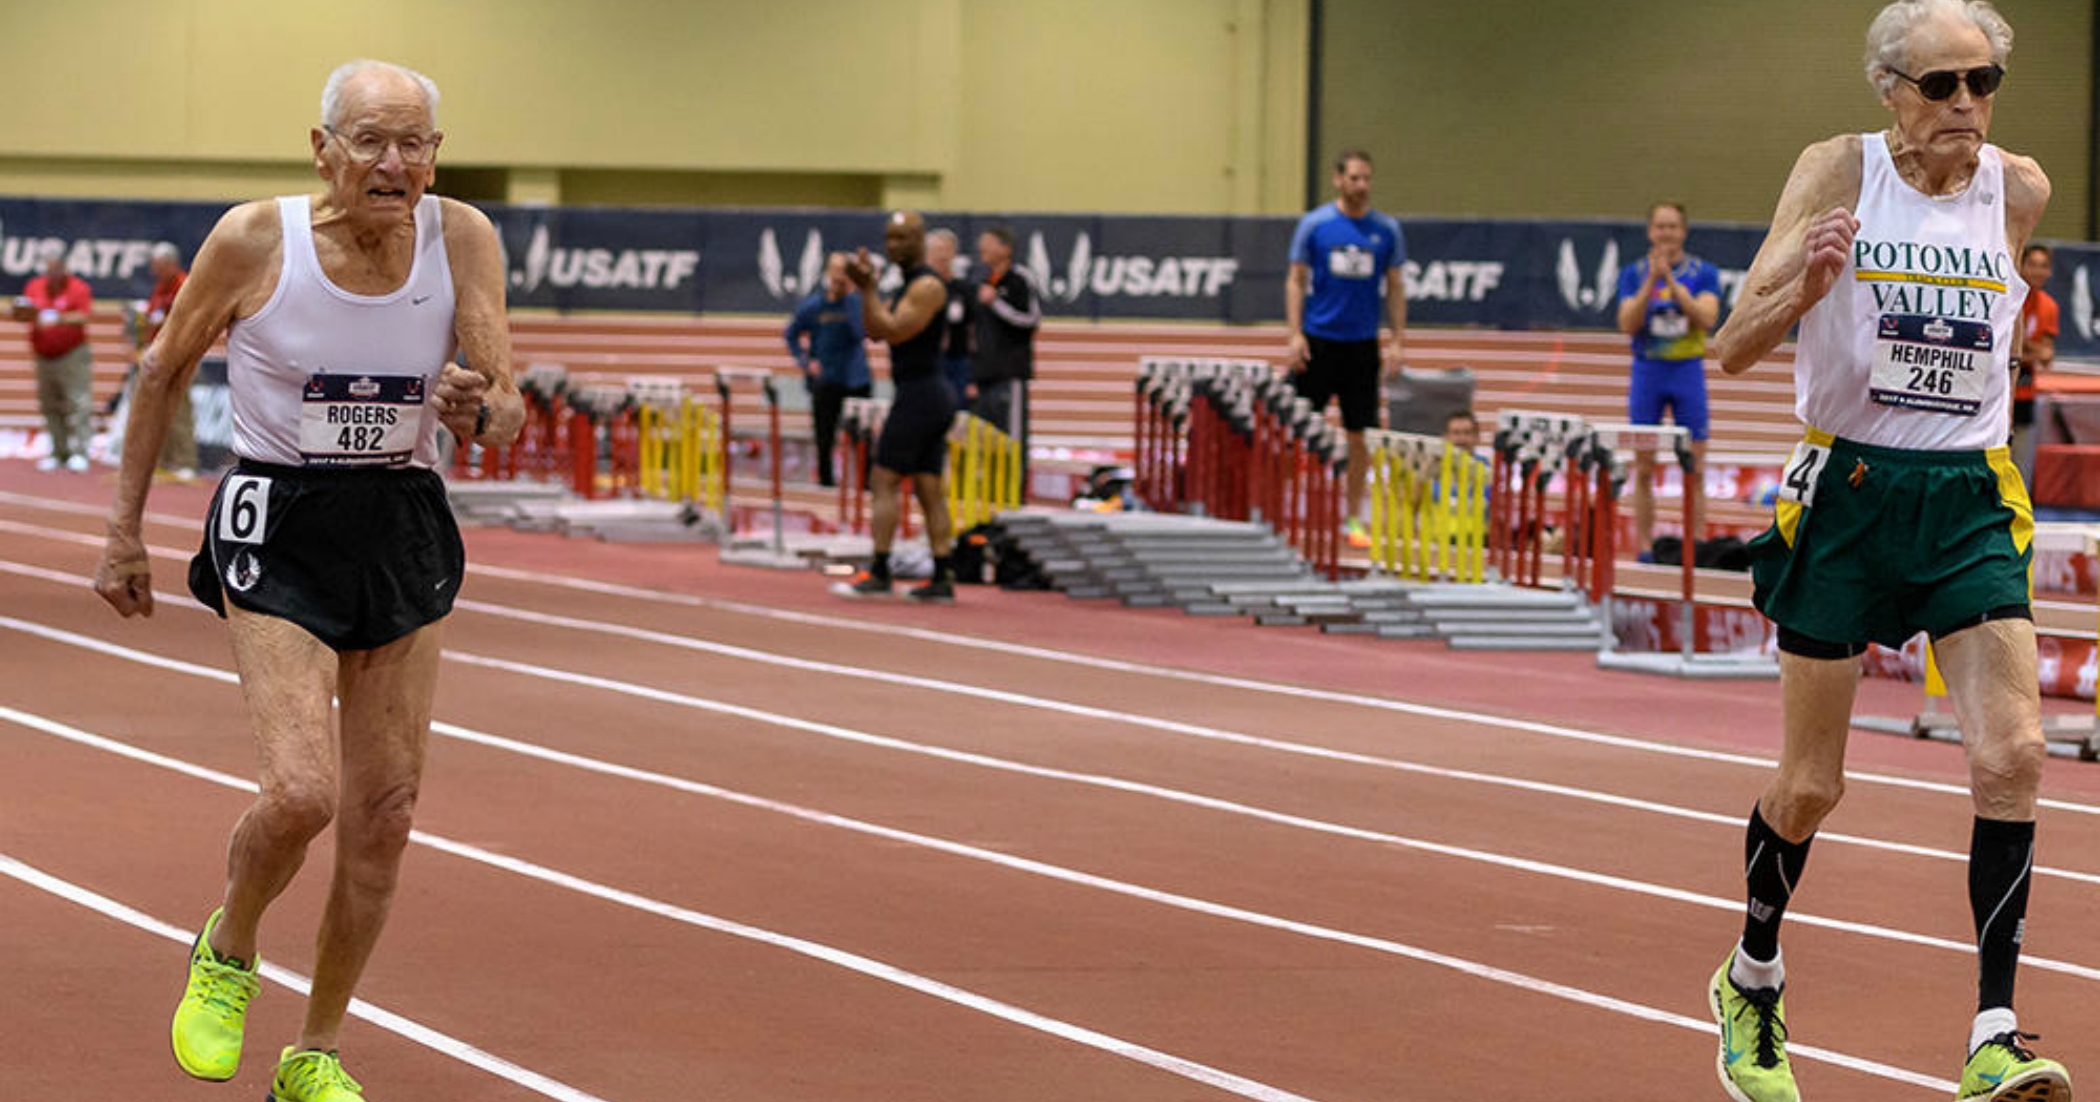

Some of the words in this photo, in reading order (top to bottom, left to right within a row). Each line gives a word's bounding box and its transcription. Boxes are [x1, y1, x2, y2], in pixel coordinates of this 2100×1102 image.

[550, 247, 700, 289] USATF
[1092, 255, 1240, 296] USATF
[1380, 259, 1503, 301] SATF
[1855, 240, 2008, 280] POTOMAC
[1871, 284, 1997, 320] VALLEY
[1891, 344, 1975, 371] HEMPHILL
[1907, 367, 1953, 394] 246
[327, 405, 398, 425] ROGERS
[338, 426, 384, 450] 482
[1787, 448, 1819, 500] 4
[231, 480, 259, 538] 6
